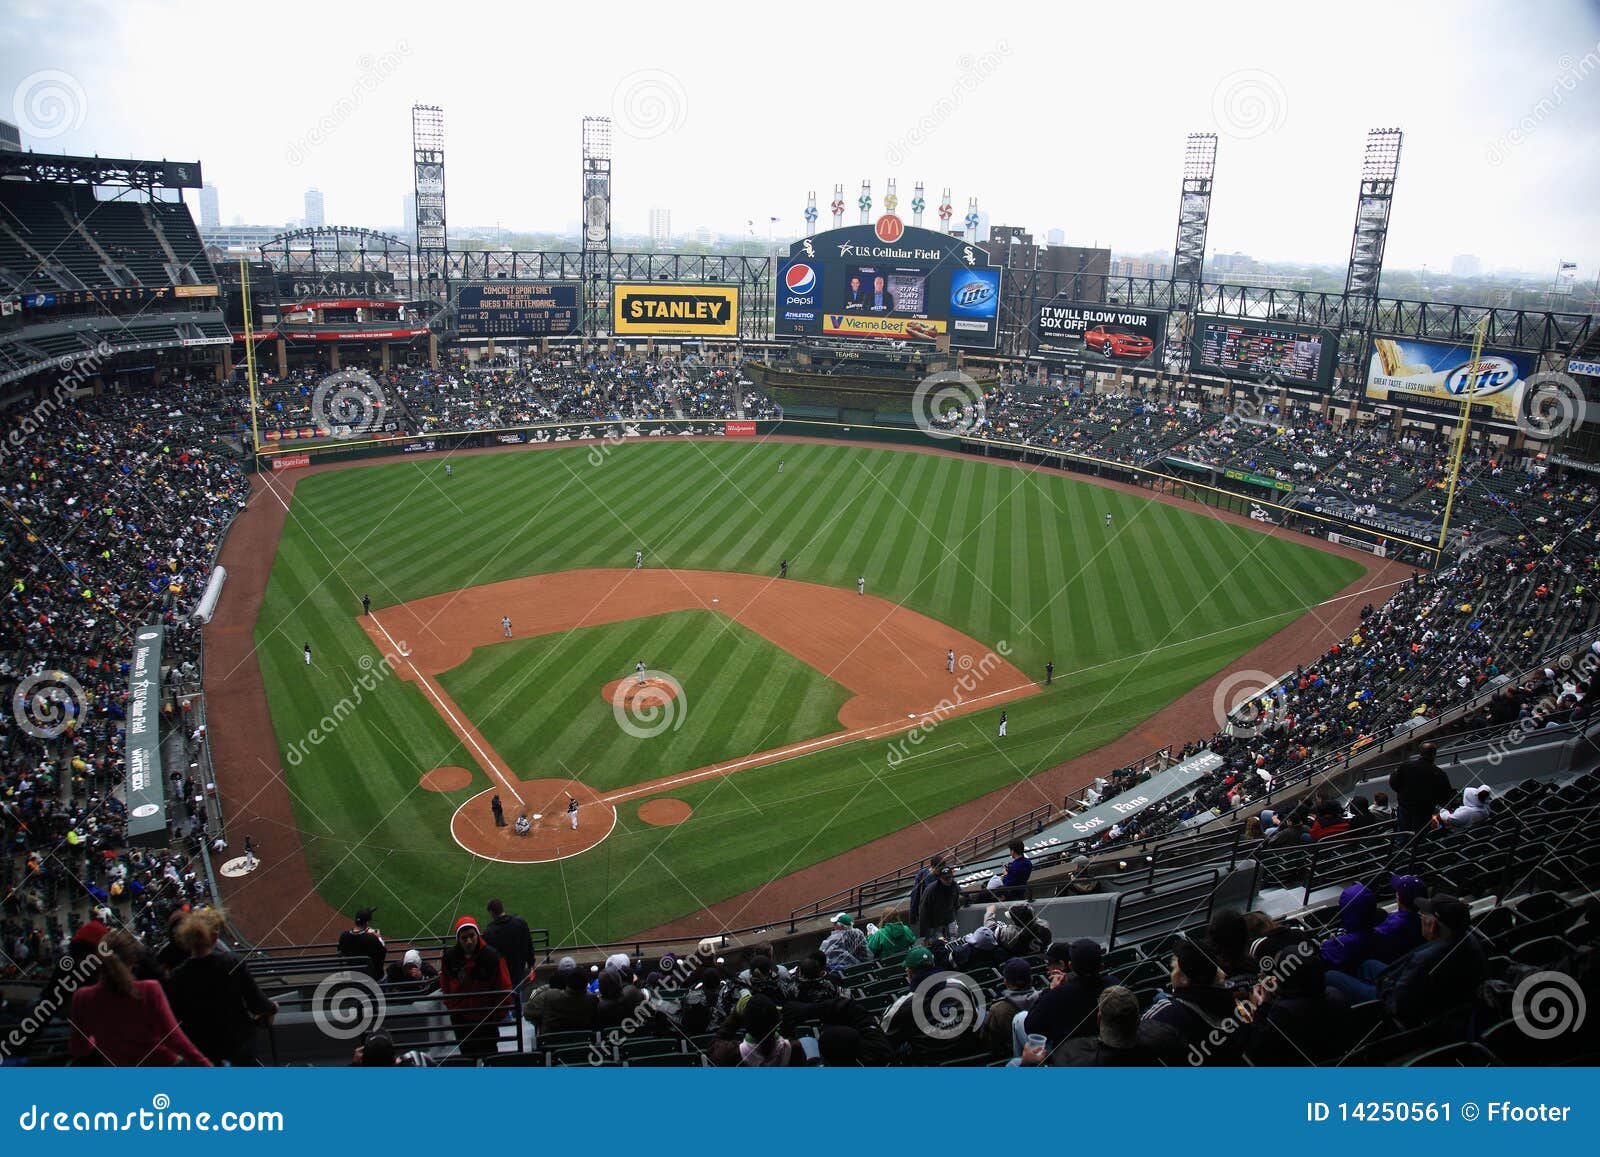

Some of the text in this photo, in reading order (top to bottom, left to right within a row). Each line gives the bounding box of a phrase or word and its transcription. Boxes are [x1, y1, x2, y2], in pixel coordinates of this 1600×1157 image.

[872, 247, 913, 259] Cellular
[914, 248, 940, 260] Field
[483, 286, 514, 295] COMCAST
[502, 299, 514, 308] THE
[786, 296, 814, 306] pepsi
[480, 311, 489, 319] 23
[630, 300, 722, 319] STANLEY
[1041, 307, 1148, 326] IT WILL BLOW YOUR
[846, 318, 904, 333] Vienna Beef
[1040, 317, 1088, 331] SOX OFF!
[1373, 377, 1387, 386] GREAT
[1405, 381, 1417, 390] LESS
[1322, 508, 1343, 518] MILLER
[1360, 518, 1386, 530] BULLPEN
[1386, 524, 1409, 536] SPORTS
[136, 646, 150, 670] Welcome
[132, 716, 146, 734] Field
[132, 748, 144, 792] WHITE SOX
[1112, 795, 1149, 814] Fans
[1072, 816, 1105, 833] Sox
